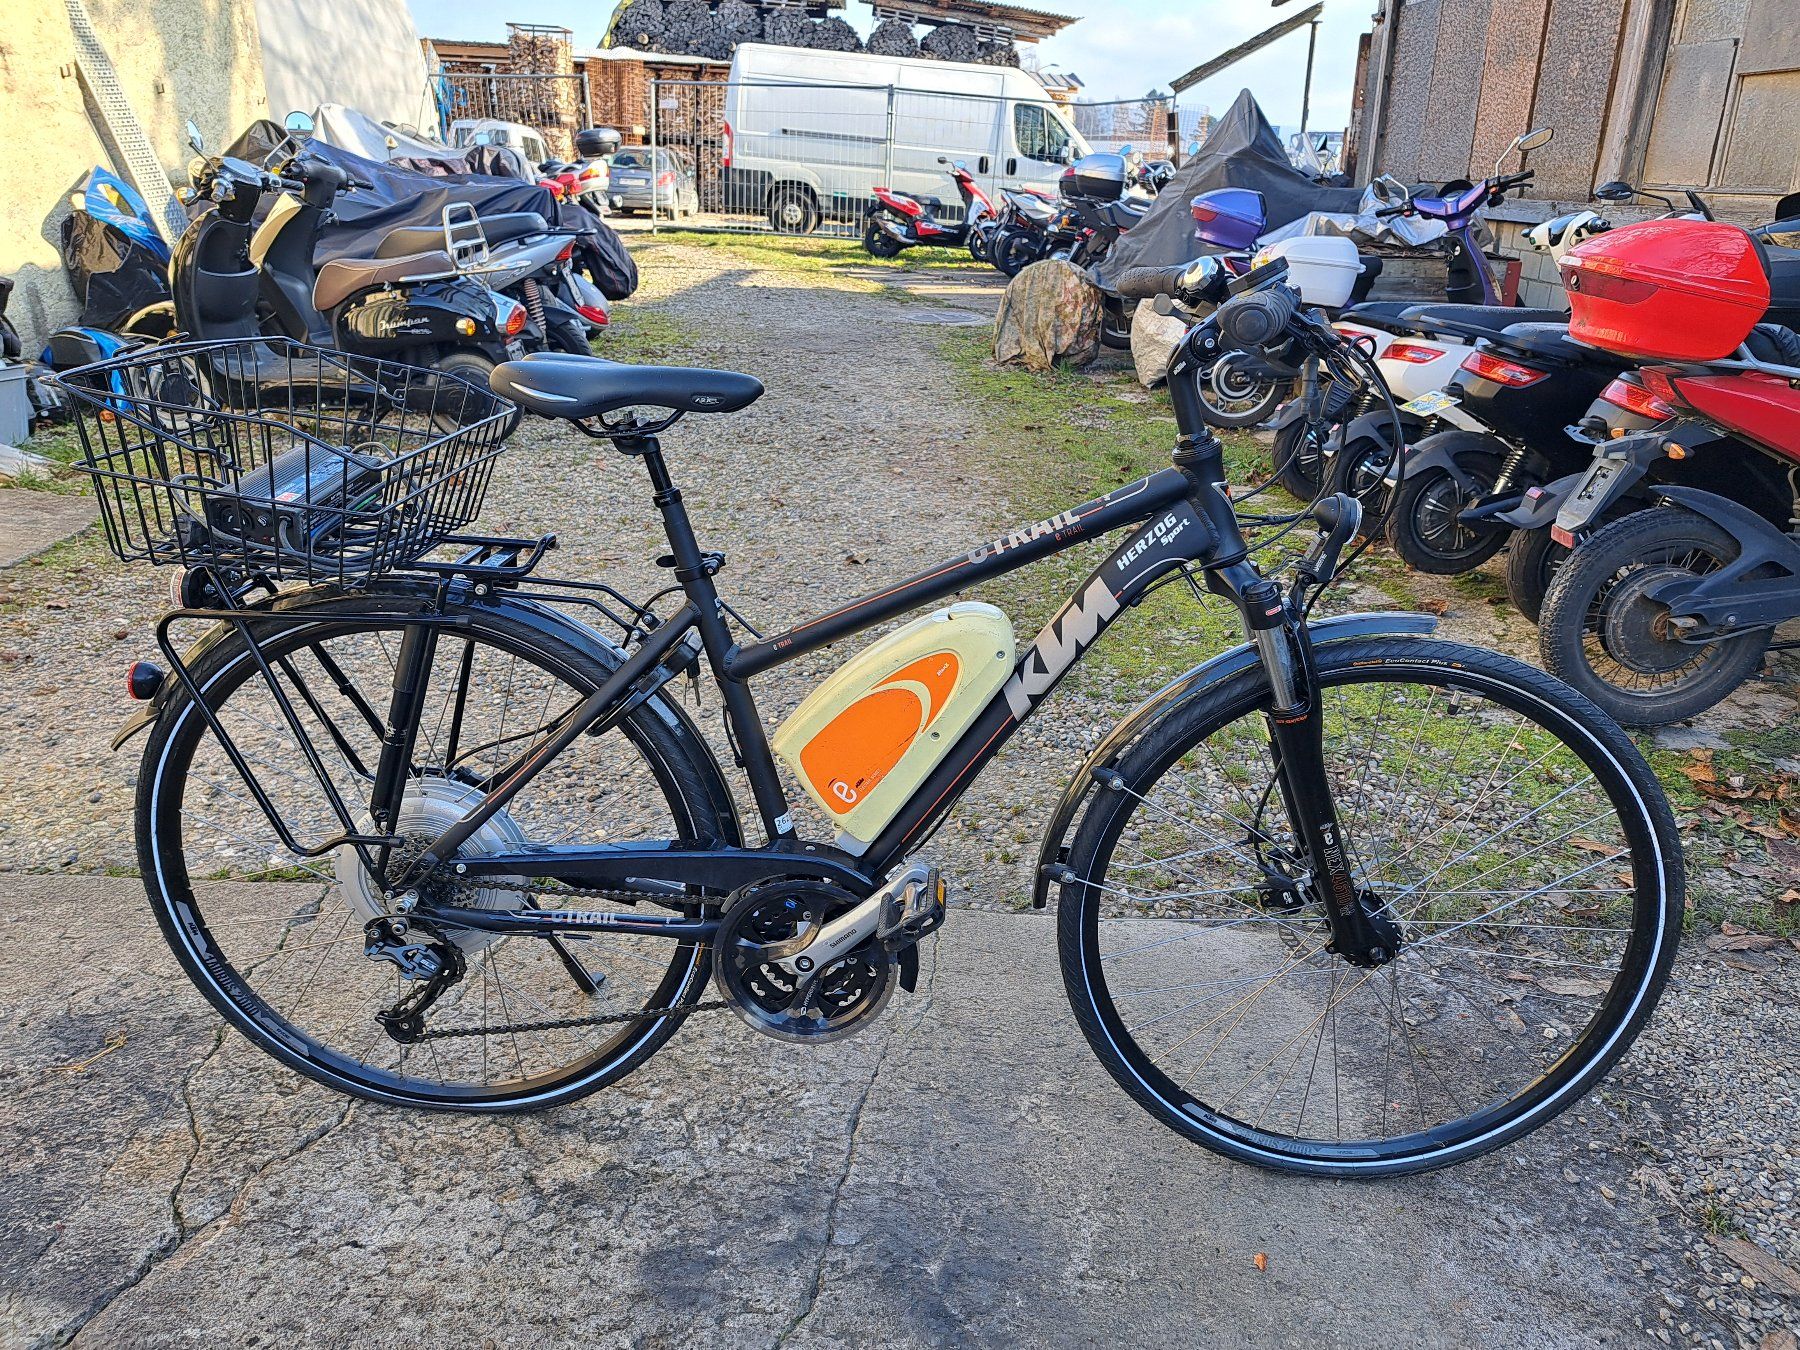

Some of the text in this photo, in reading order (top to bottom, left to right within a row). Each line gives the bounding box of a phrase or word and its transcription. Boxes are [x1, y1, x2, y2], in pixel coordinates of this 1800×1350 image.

[1116, 512, 1178, 571] HERZOG
[1160, 518, 1191, 546] Sport
[1002, 575, 1121, 722] KTM
[832, 781, 858, 803] e
[1323, 844, 1345, 876] NEX
[829, 927, 857, 949] SHIMANO
